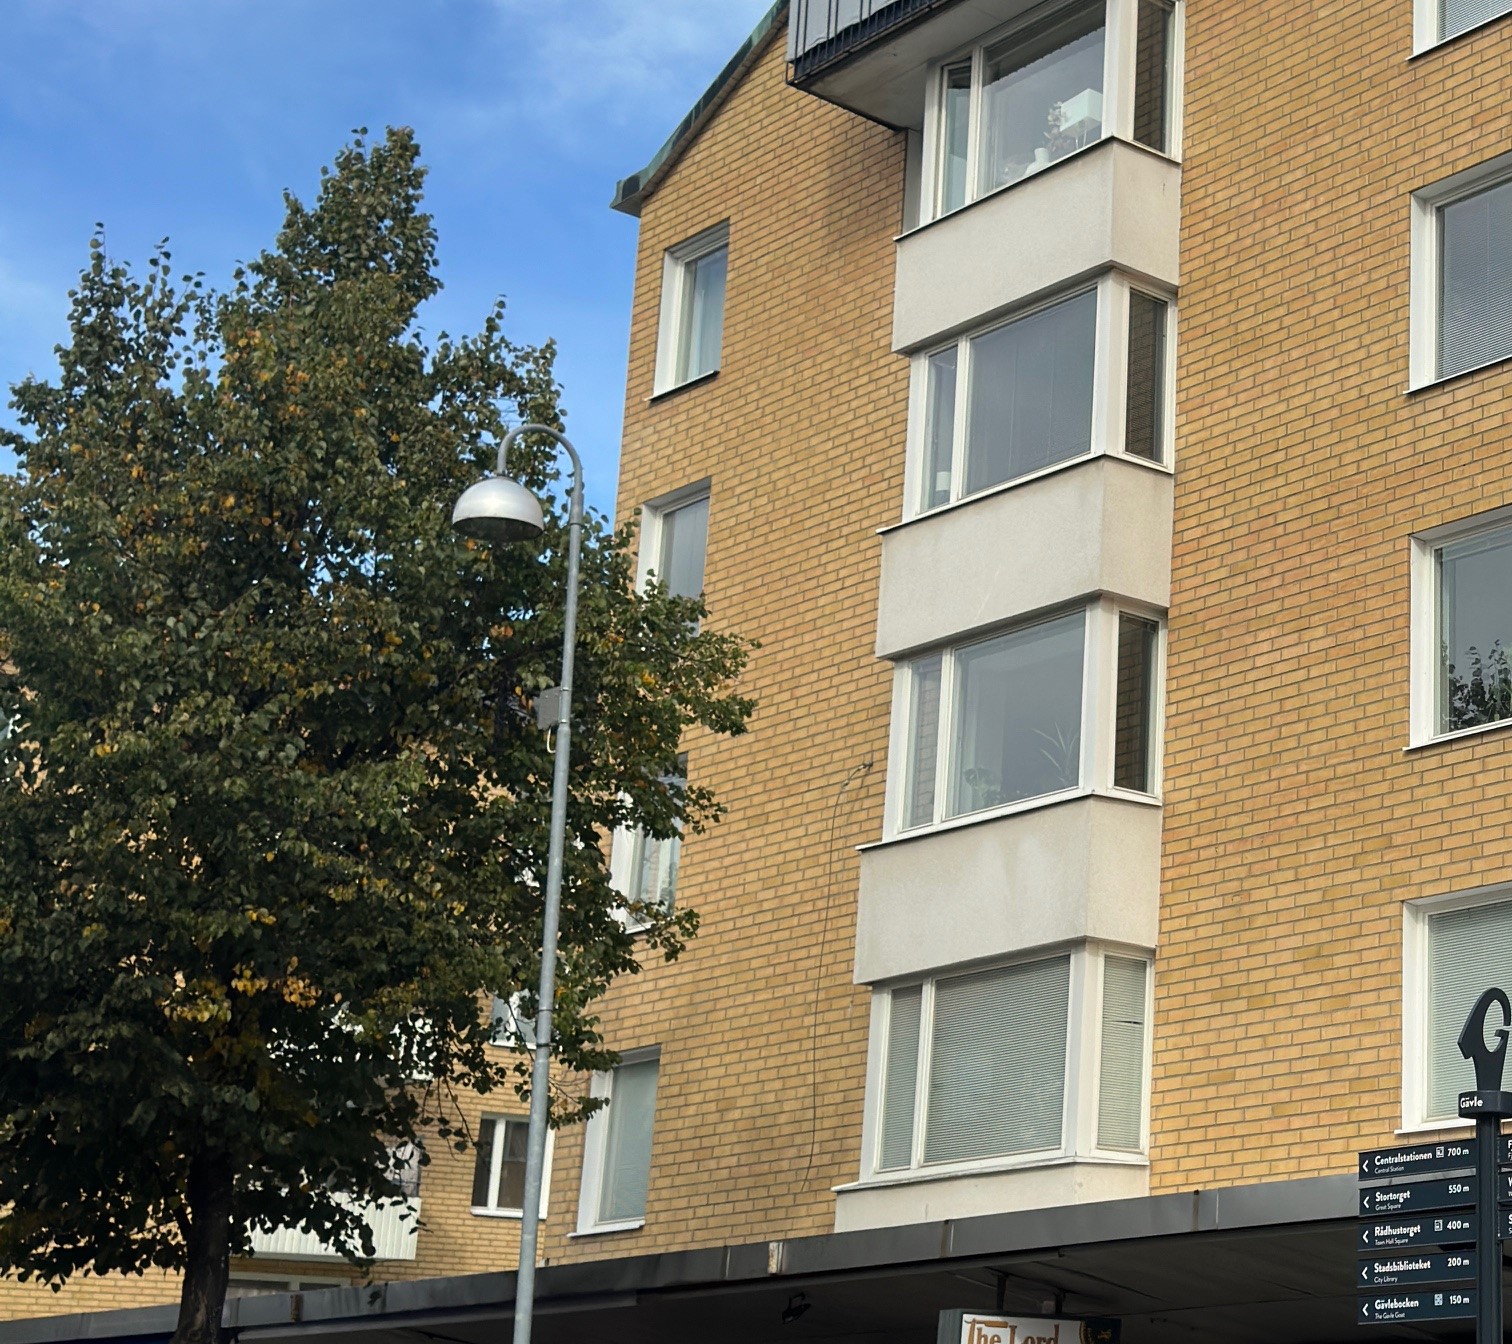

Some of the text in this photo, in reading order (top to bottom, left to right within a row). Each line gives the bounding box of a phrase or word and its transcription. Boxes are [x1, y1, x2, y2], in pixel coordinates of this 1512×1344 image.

[1460, 1096, 1483, 1108] Gävle
[1374, 1151, 1433, 1166] Centralstationen
[1447, 1147, 1461, 1157] 700
[1375, 1190, 1411, 1203] Stortorget
[1448, 1184, 1461, 1194] 550
[1374, 1225, 1421, 1237] Rådhustorget
[1446, 1221, 1461, 1230] 400
[1374, 1259, 1431, 1273] Stadsbiblioteket
[1447, 1257, 1461, 1267] 200
[1374, 1297, 1419, 1310] Gävlebocken
[1449, 1295, 1461, 1305] 150
